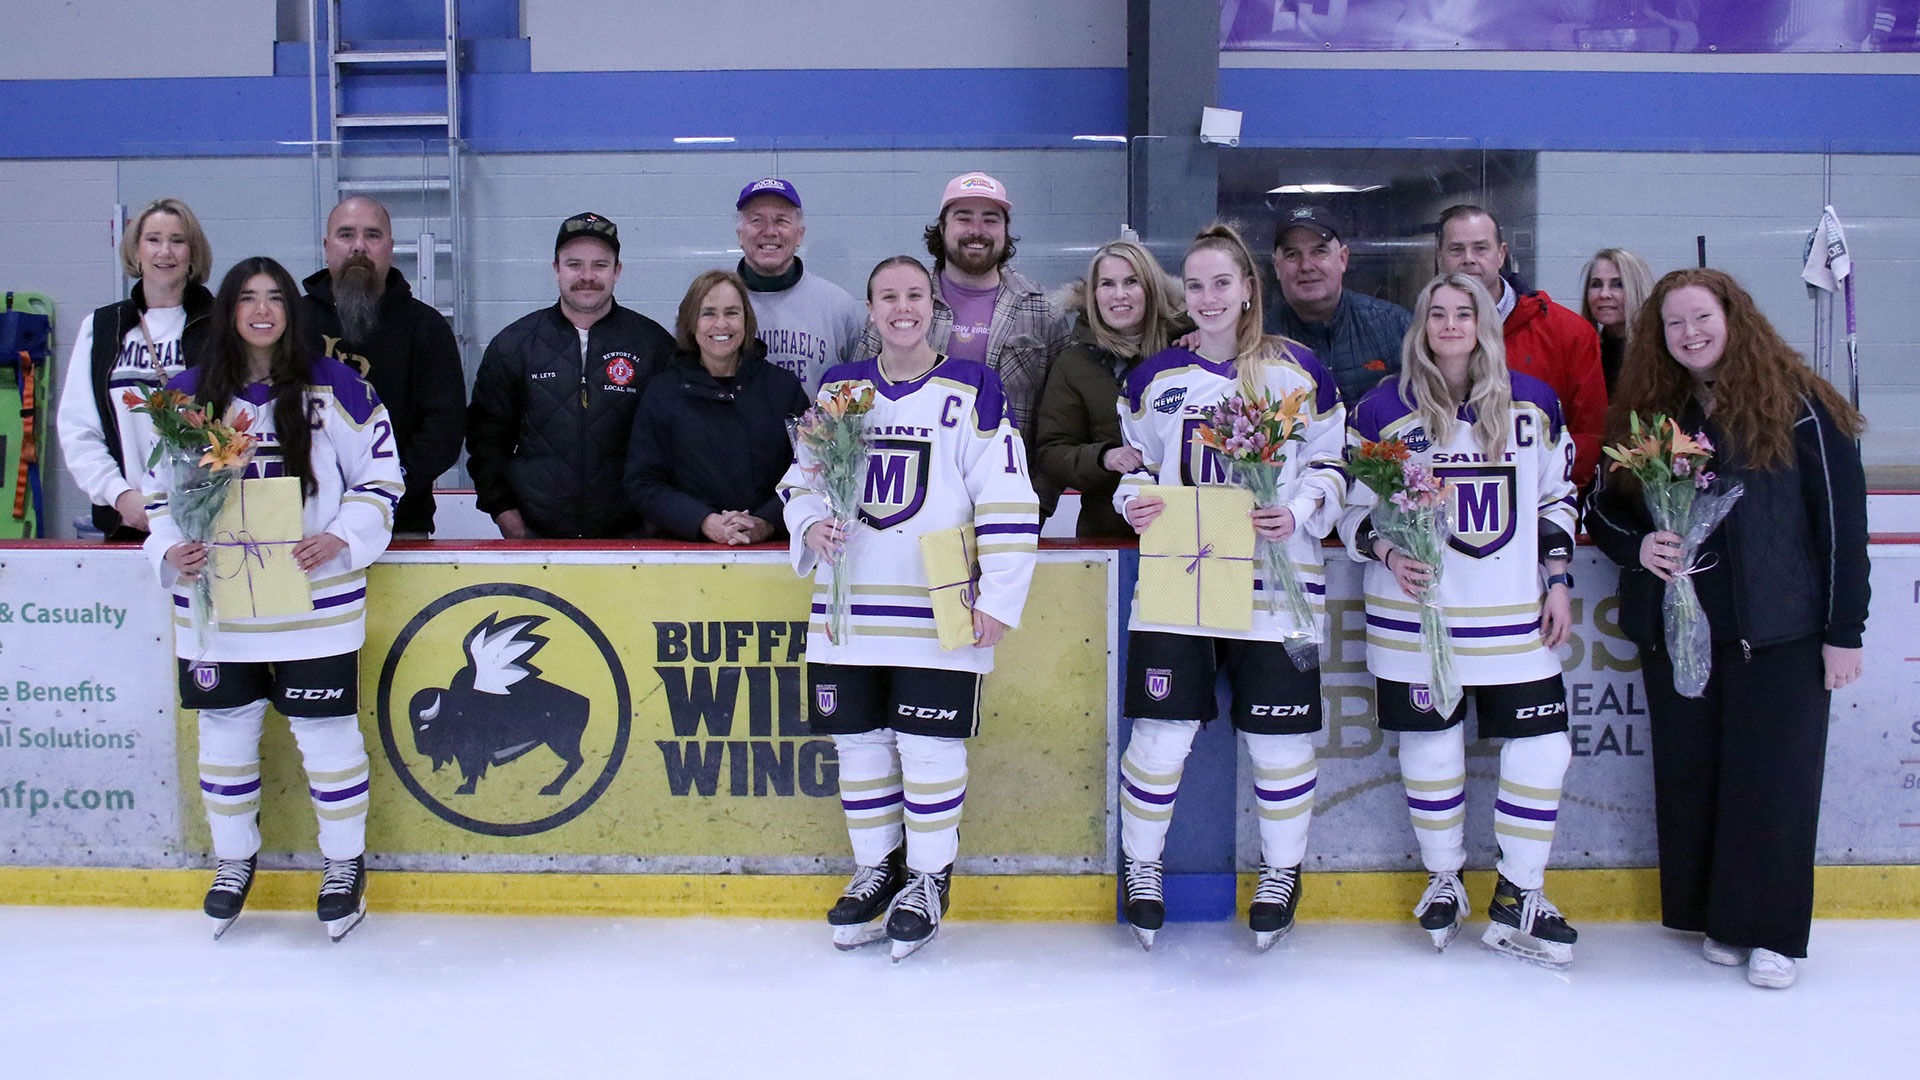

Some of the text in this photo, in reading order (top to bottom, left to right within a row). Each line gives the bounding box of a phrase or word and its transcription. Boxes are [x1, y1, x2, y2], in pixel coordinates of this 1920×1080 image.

[940, 395, 962, 428] C
[371, 420, 393, 459] 2
[868, 426, 933, 437] AINT
[1515, 414, 1534, 447] C
[1432, 452, 1516, 463] SAIT
[1563, 442, 1574, 482] 8
[863, 454, 911, 504] M
[1456, 482, 1502, 533] M
[21, 602, 127, 630] Casualty
[652, 621, 809, 662] BUFFA
[16, 680, 117, 702] Benefits
[285, 687, 344, 700] CCM
[653, 666, 829, 737] WIL
[1564, 683, 1645, 716] EAL
[897, 703, 959, 721] CCM
[1251, 704, 1310, 717] CCM
[1515, 701, 1566, 720] CCM
[19, 727, 135, 749] Solutions
[1571, 724, 1644, 757] EAL
[654, 740, 840, 798] WING
